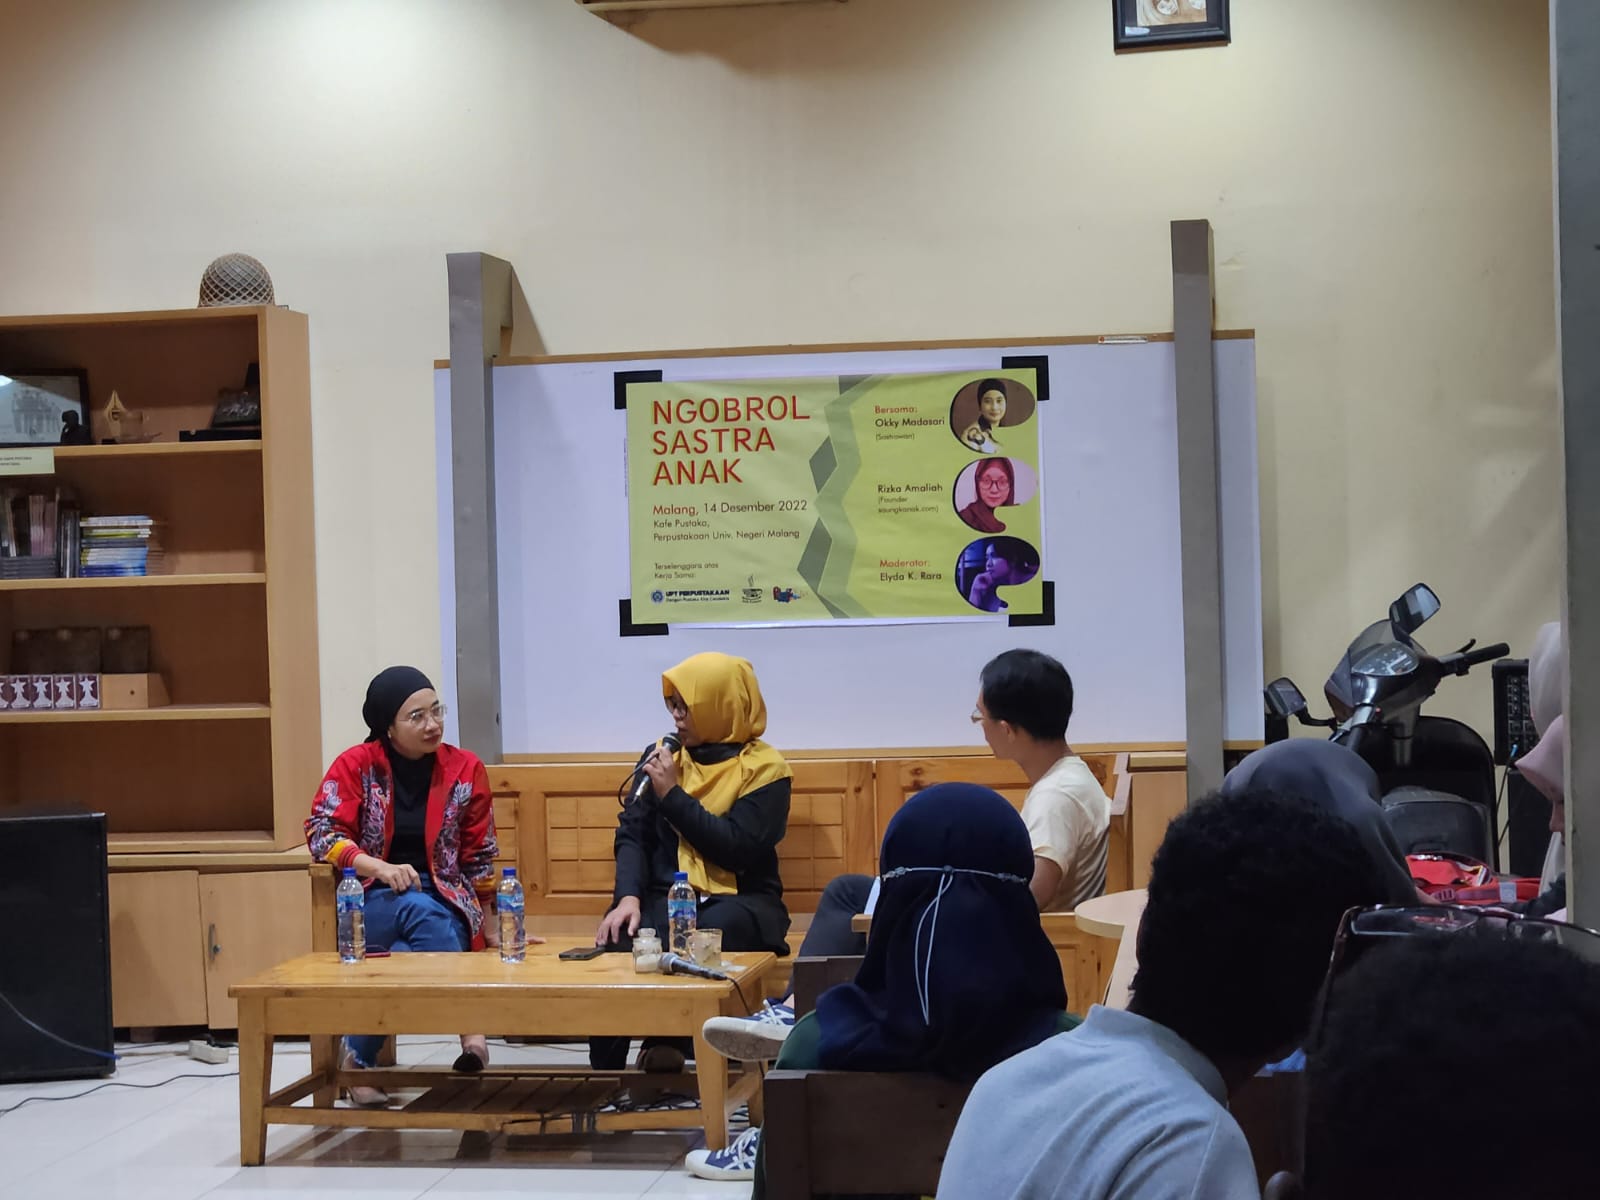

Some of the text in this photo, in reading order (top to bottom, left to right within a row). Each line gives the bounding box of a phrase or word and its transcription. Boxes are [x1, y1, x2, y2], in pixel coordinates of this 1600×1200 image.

[653, 395, 811, 425] NGOBROL
[874, 405, 918, 414] Bersama:
[875, 416, 945, 430] Okky Madasari
[653, 427, 776, 456] SASTRA
[653, 458, 744, 486] ANAK
[878, 482, 943, 493] Rizka Amaliah
[653, 500, 808, 517] Malang, 14 Desember 2022
[653, 518, 711, 529] Kafe Pustaka,
[653, 529, 800, 543] Perpustakaan Univ. Negeri Malang
[704, 561, 719, 569] atas
[880, 571, 905, 582] Elyda
[920, 571, 942, 580] Rara
